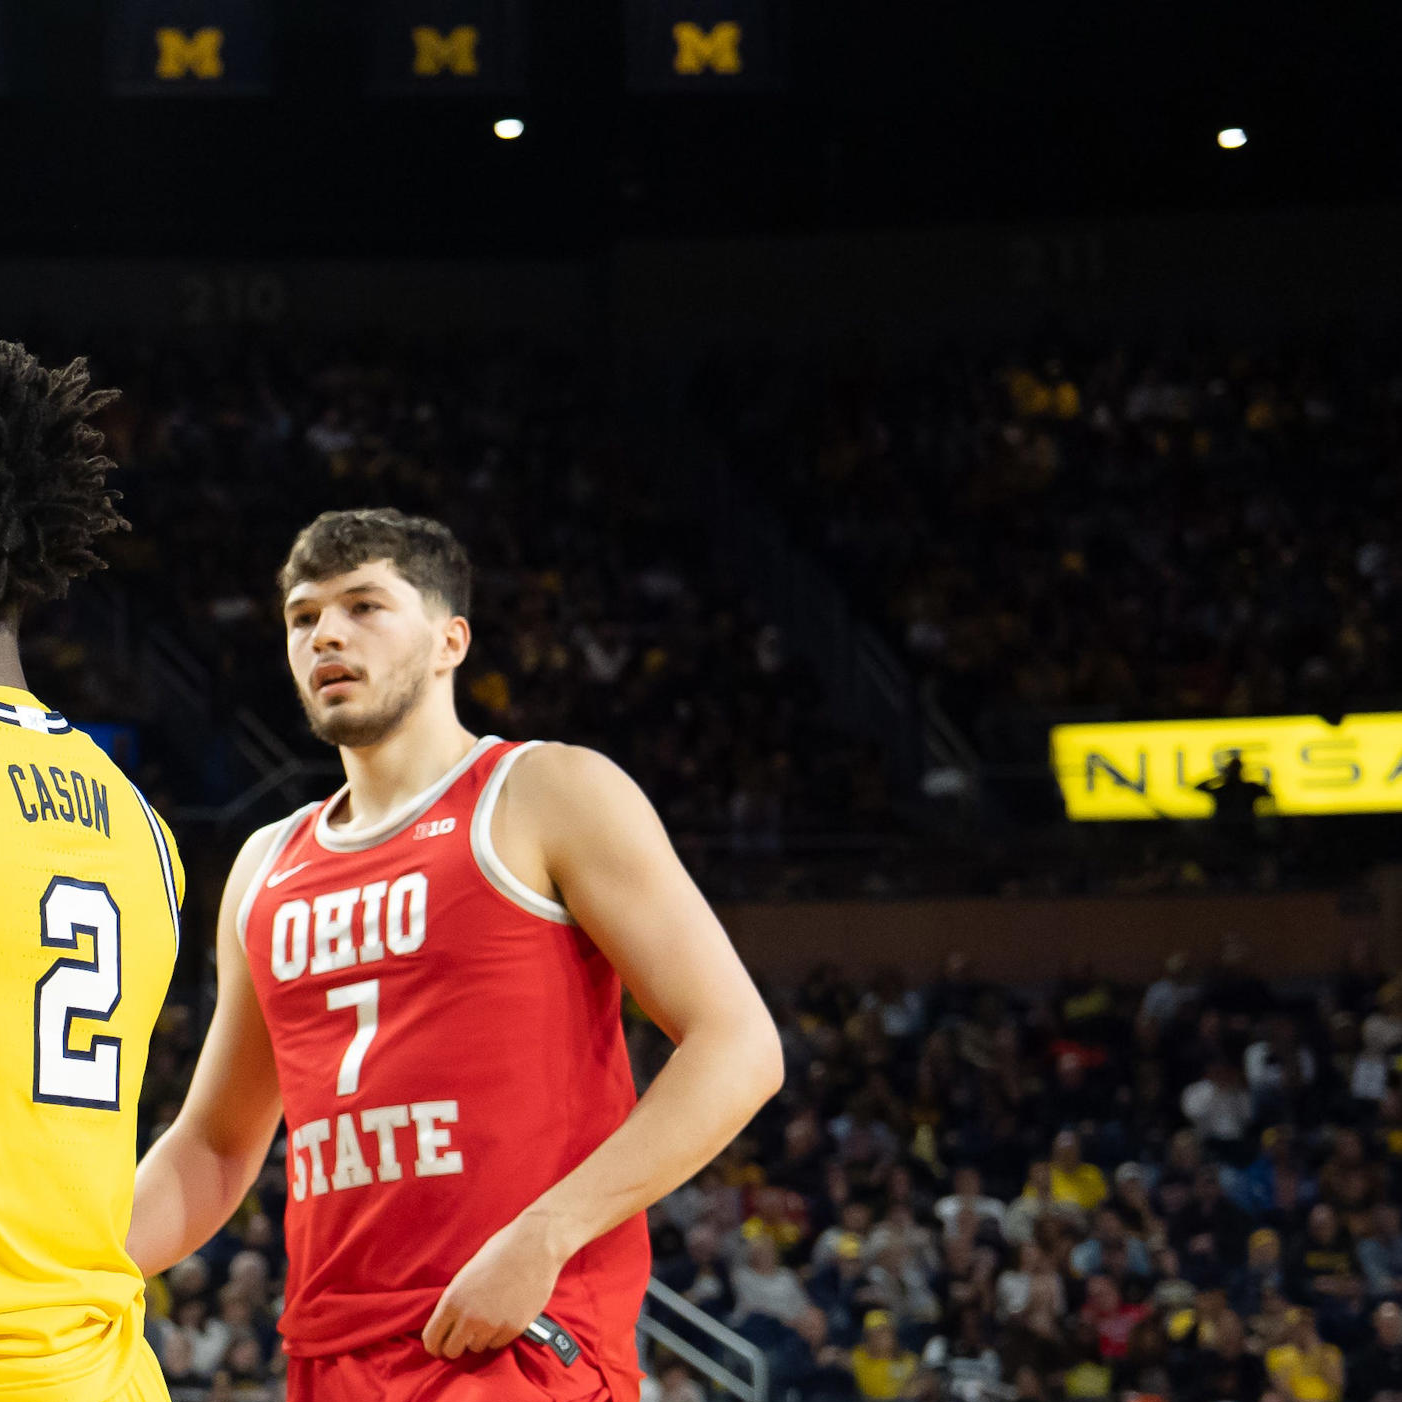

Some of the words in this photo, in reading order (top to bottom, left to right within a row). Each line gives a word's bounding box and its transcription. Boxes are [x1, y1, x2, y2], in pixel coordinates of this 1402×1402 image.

[155, 26, 224, 79] M
[412, 24, 479, 76] M
[672, 20, 742, 75] M
[8, 764, 111, 839] CASON
[271, 872, 427, 982] OHIO
[33, 875, 122, 1111] 2
[326, 979, 379, 1097] 7
[293, 1100, 464, 1201] STATE
